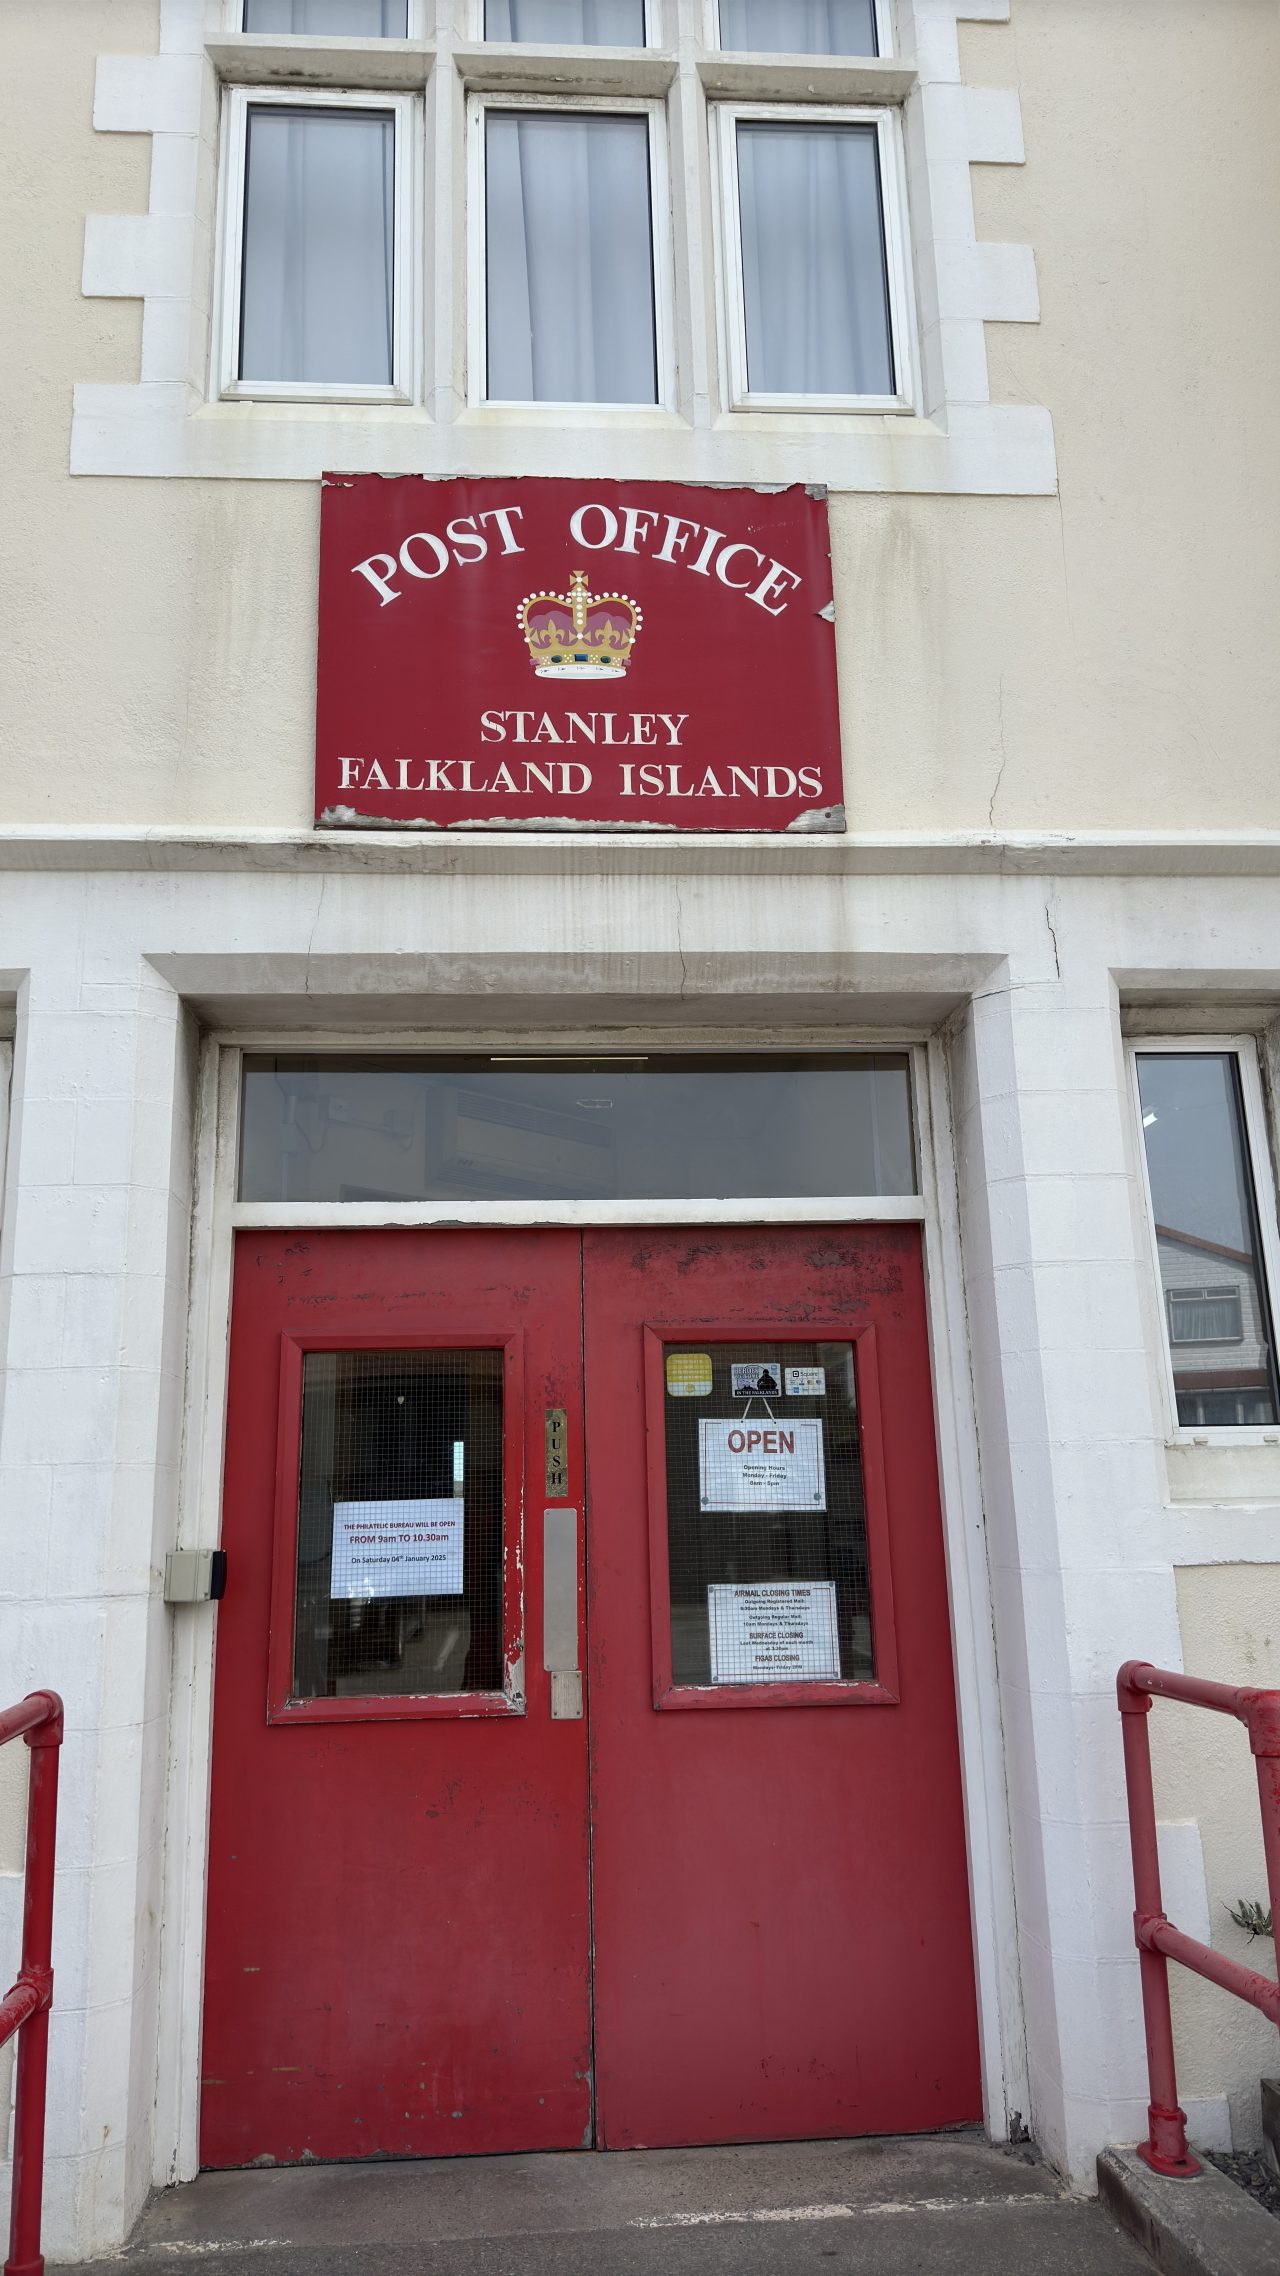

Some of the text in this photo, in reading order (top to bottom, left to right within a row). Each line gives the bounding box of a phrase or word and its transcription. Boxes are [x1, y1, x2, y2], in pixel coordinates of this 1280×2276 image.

[351, 504, 802, 616] POST OFFICE
[481, 710, 689, 745] STANLEY
[338, 757, 823, 798] FALKLAND ISLANDS
[552, 1421, 562, 1485] PUSH
[727, 1429, 795, 1454] OPEN
[350, 1533, 449, 1544] FROM 9am TO 10.30am
[362, 1556, 390, 1564] Saturday
[761, 1589, 790, 1597] CLOSING
[791, 1589, 811, 1597] TIMES
